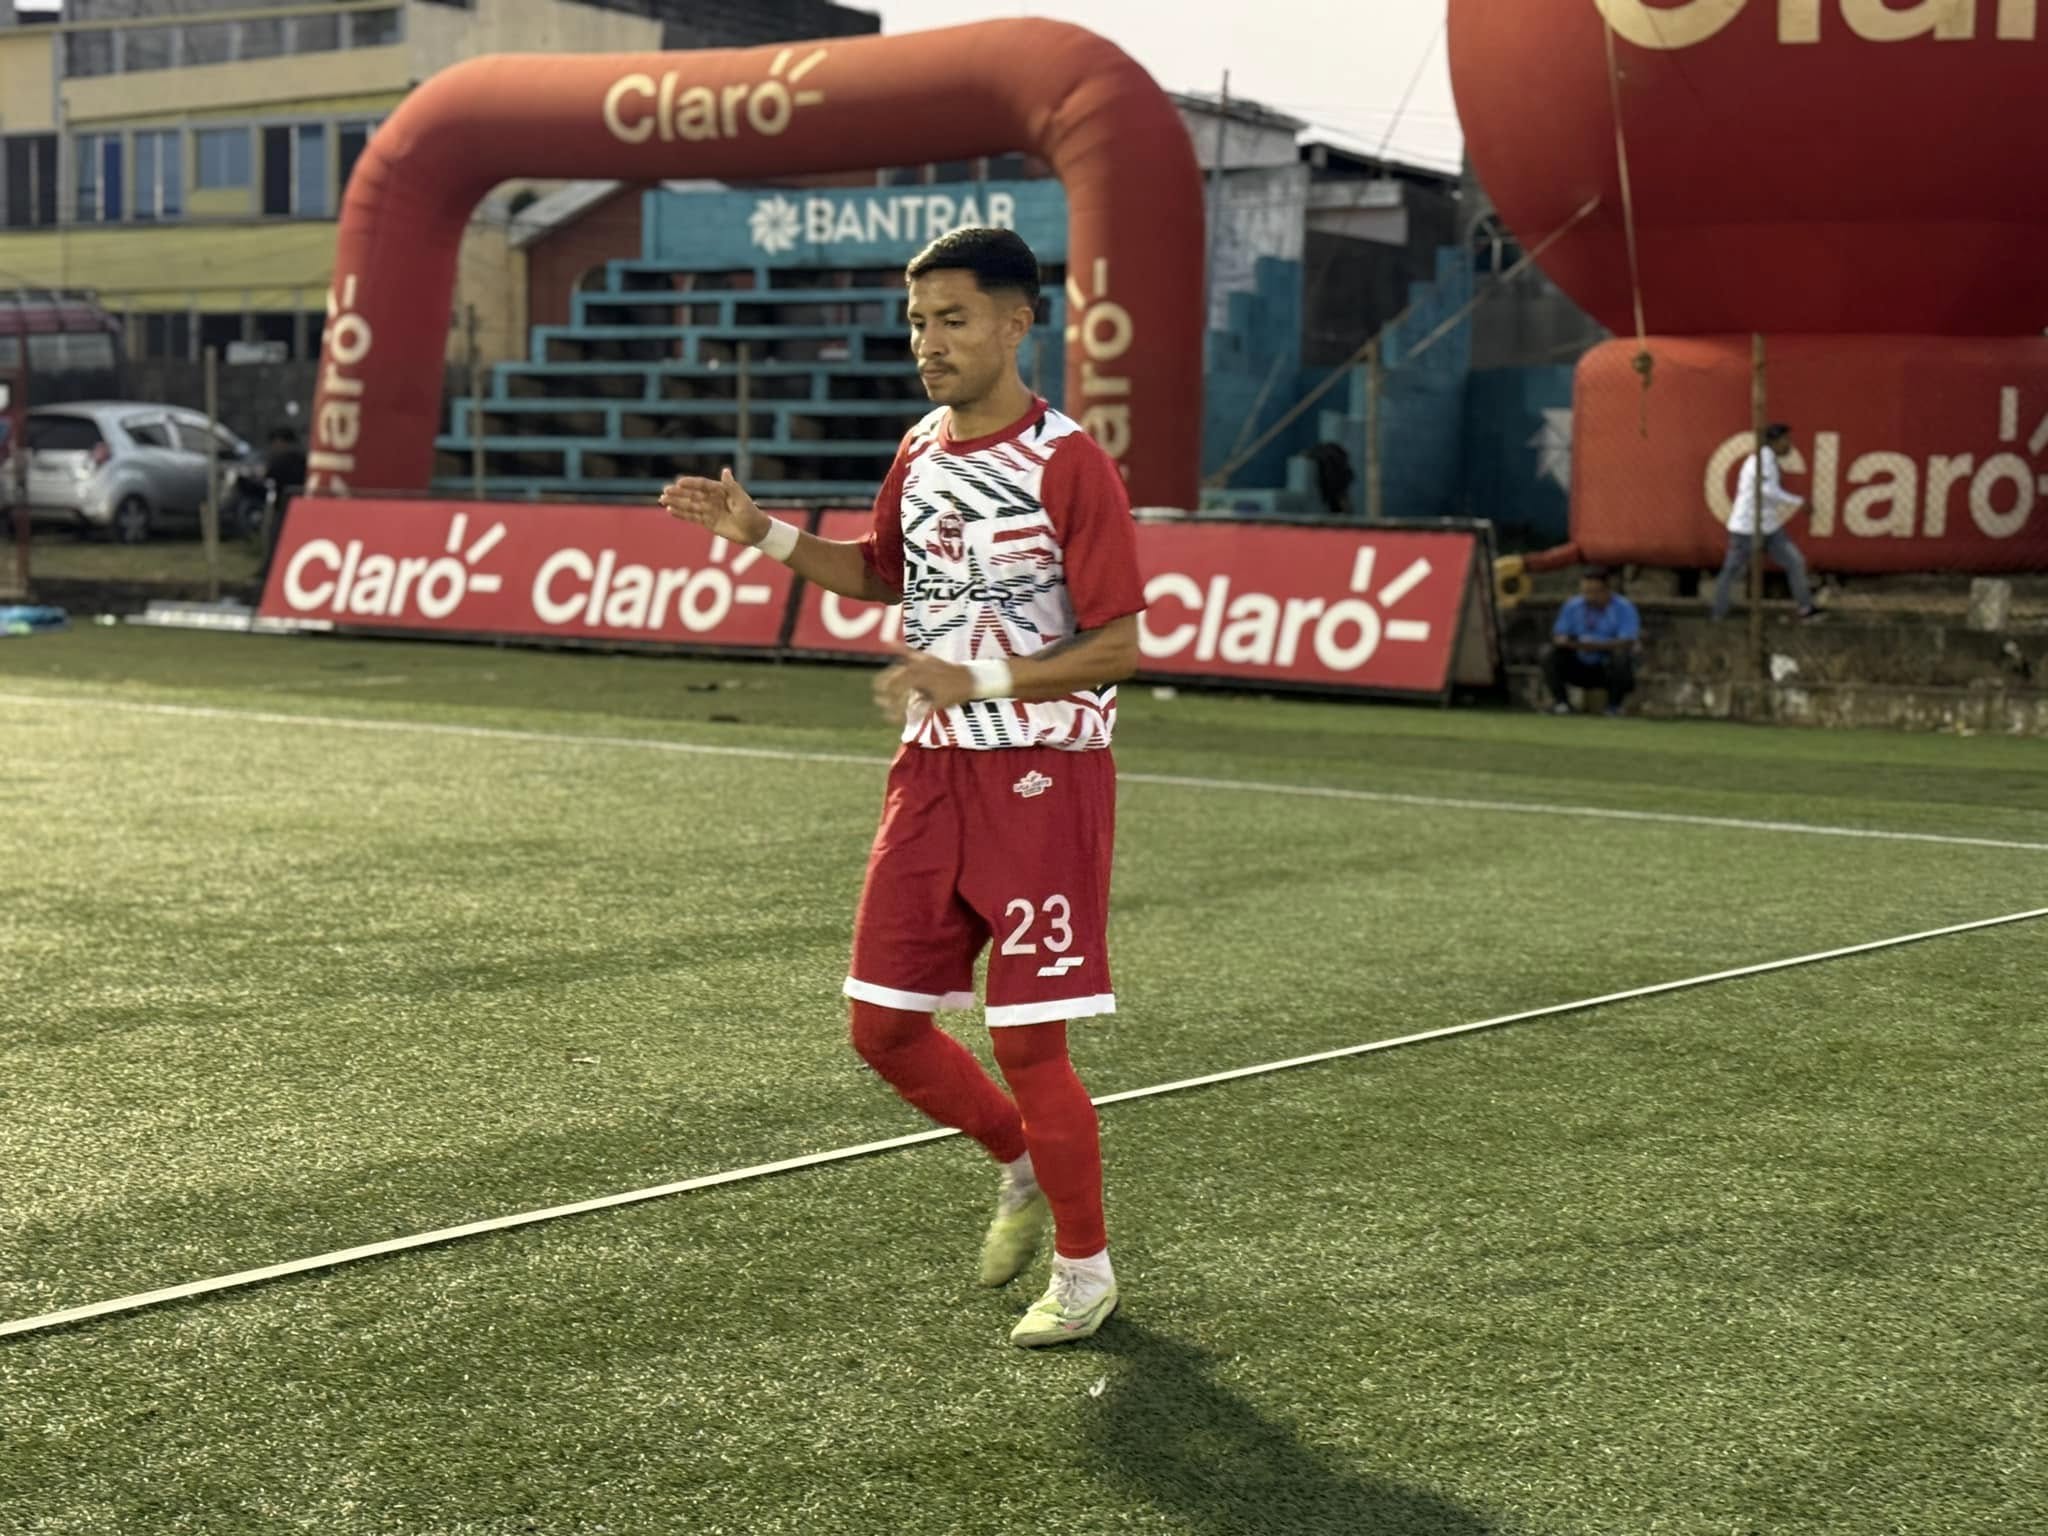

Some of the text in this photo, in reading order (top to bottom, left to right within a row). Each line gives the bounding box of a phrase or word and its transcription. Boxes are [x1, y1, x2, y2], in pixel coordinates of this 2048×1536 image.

[604, 69, 793, 144] Claro
[1081, 301, 1133, 482] aro
[282, 538, 467, 619] Claro
[532, 547, 734, 633] Claro
[1136, 571, 1382, 671] Claro
[1001, 894, 1073, 956] 23
